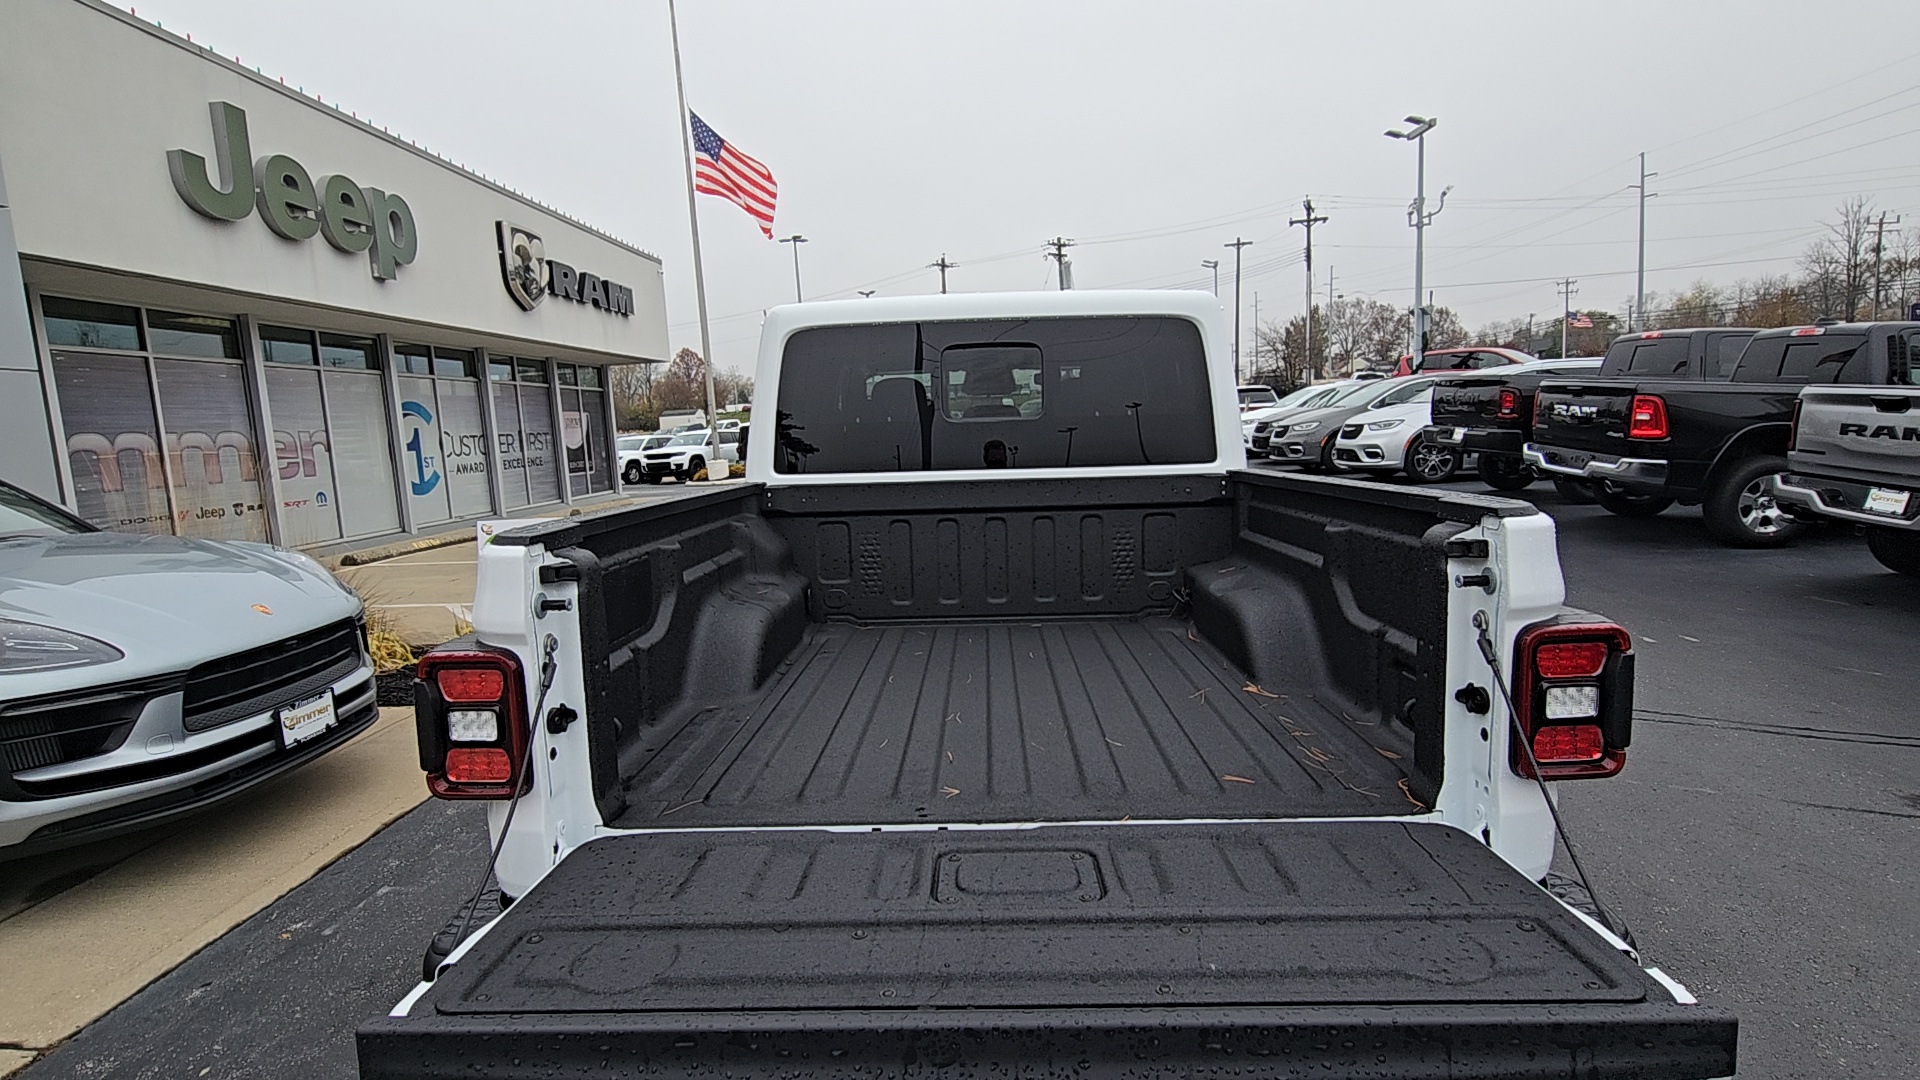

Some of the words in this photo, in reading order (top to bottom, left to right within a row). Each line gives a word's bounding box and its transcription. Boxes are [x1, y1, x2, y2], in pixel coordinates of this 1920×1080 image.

[166, 100, 418, 282] Jeep
[546, 258, 636, 318] RAM
[1552, 403, 1599, 418] RAM
[440, 430, 516, 458] CUSTOER
[455, 462, 485, 475] AWARD
[502, 456, 544, 471] EXCELENCE
[283, 499, 310, 509] SRT
[120, 514, 171, 526] DODG
[195, 506, 226, 520] Jeep
